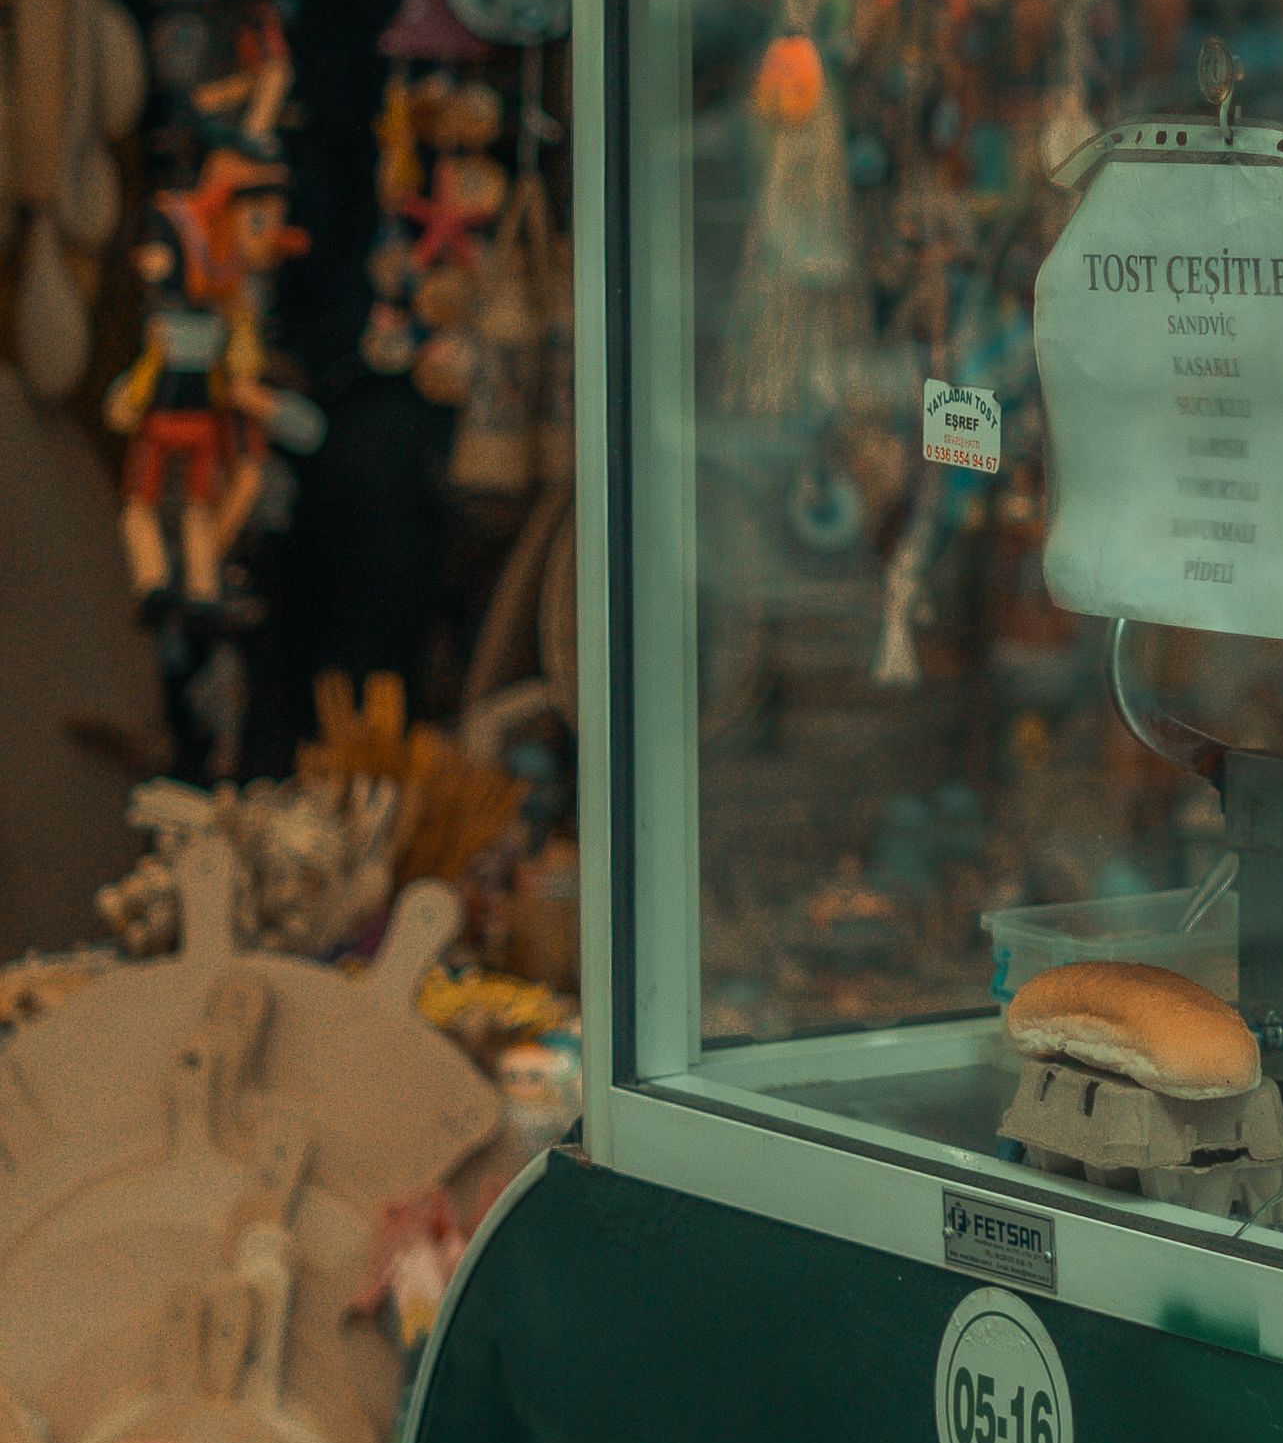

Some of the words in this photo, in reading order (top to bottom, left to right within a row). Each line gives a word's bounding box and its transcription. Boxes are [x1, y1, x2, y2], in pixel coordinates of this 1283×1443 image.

[1083, 253, 1158, 293] TOST
[1167, 312, 1238, 340] SANDVİÇ
[927, 388, 972, 417] YAYLADAN
[974, 395, 998, 429] TOST
[945, 413, 979, 431] EŞREF
[927, 444, 933, 458] 0
[974, 1214, 1042, 1253] FETSAN
